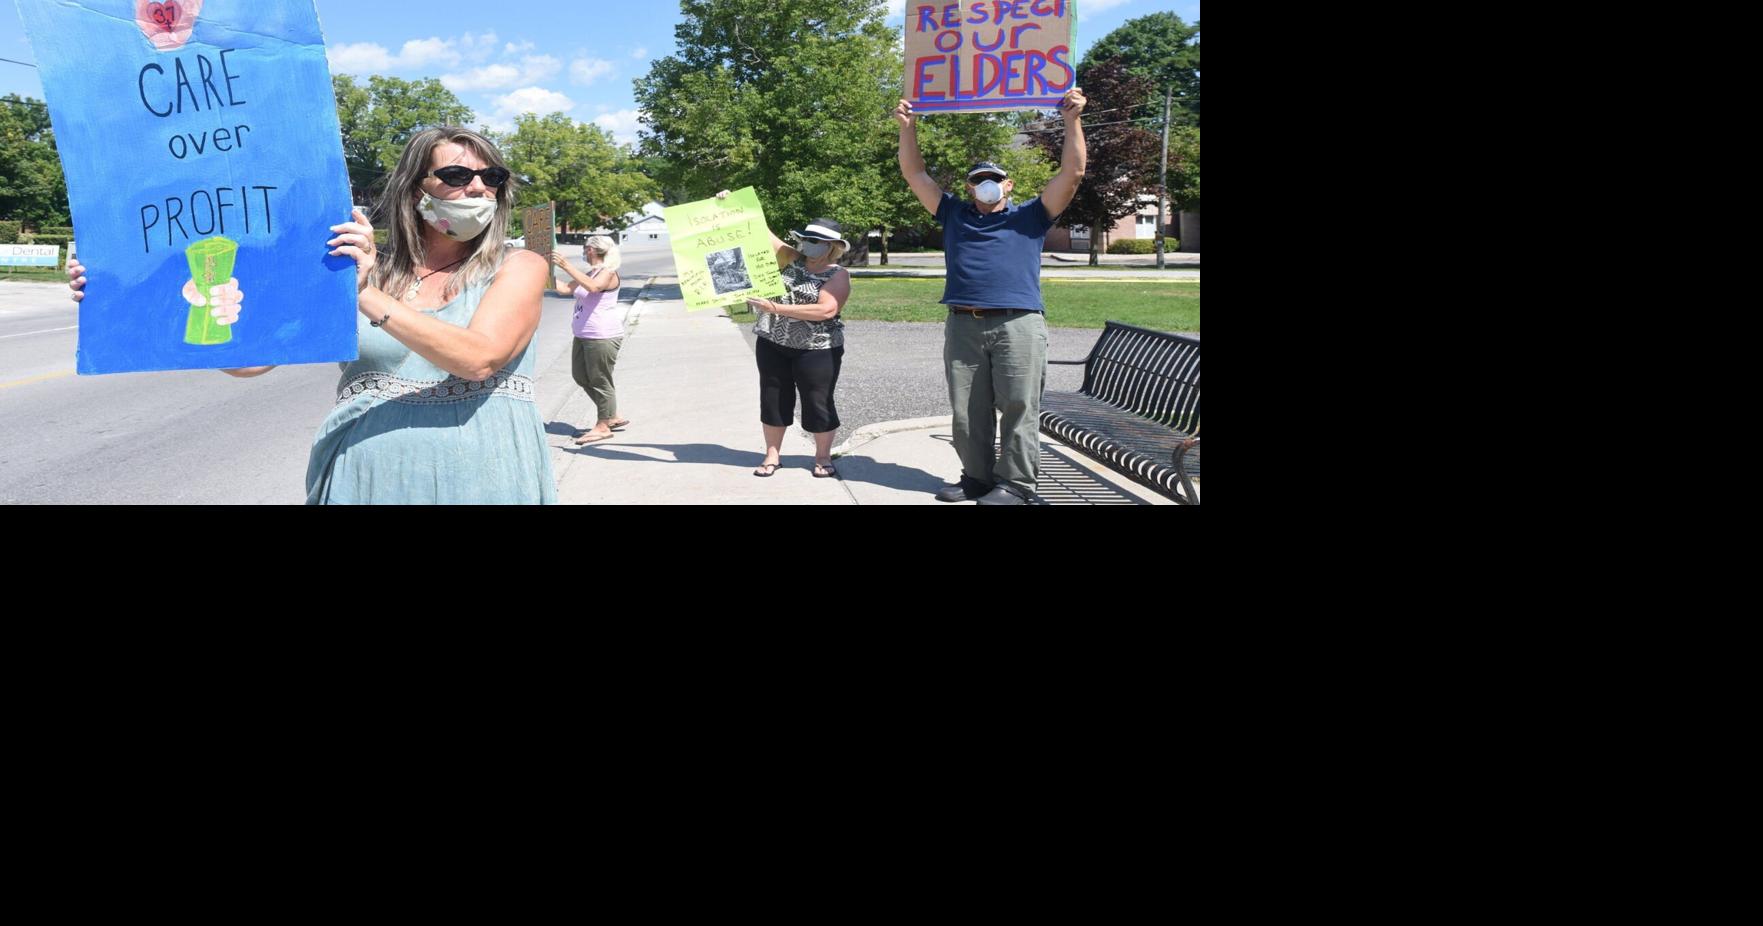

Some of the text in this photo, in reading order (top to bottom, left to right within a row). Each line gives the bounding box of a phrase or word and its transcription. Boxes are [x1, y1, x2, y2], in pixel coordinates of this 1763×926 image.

[138, 48, 247, 118] CARE
[912, 45, 1076, 102] ELDERS
[168, 124, 251, 160] over
[140, 185, 278, 254] PROFIT
[686, 206, 745, 227] ISOLATION
[12, 246, 55, 257] Dental
